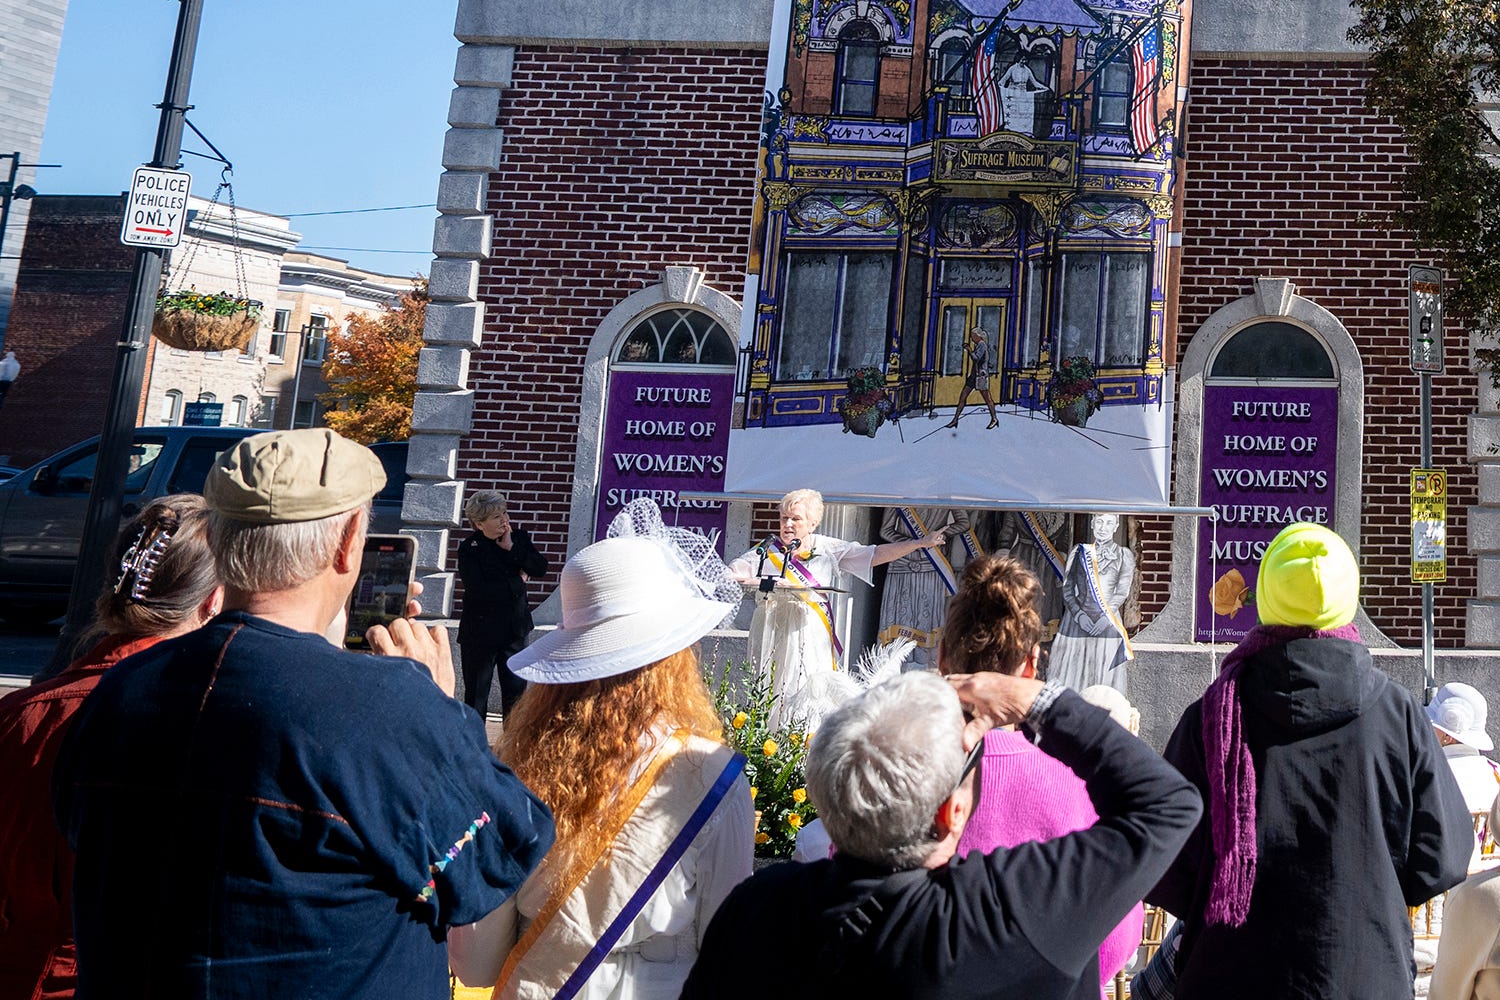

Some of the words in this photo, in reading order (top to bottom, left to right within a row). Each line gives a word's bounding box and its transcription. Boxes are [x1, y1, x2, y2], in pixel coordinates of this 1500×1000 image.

[960, 150, 1005, 168] SUFFRAGE
[137, 175, 187, 193] POLICE
[135, 193, 184, 209] VEHICLES
[135, 210, 177, 228] ONLY
[635, 387, 711, 403] FUTURE
[1232, 401, 1311, 418] FUTURE
[625, 420, 685, 436] HOME
[690, 422, 716, 437] OF
[1224, 435, 1286, 451] HOME
[1290, 436, 1317, 452] OF
[613, 453, 724, 473] WOMEN'S
[1212, 469, 1328, 488] WOMEN'S
[1414, 496, 1444, 504] TEMPORARY
[1208, 504, 1329, 524] SUFFRAGE
